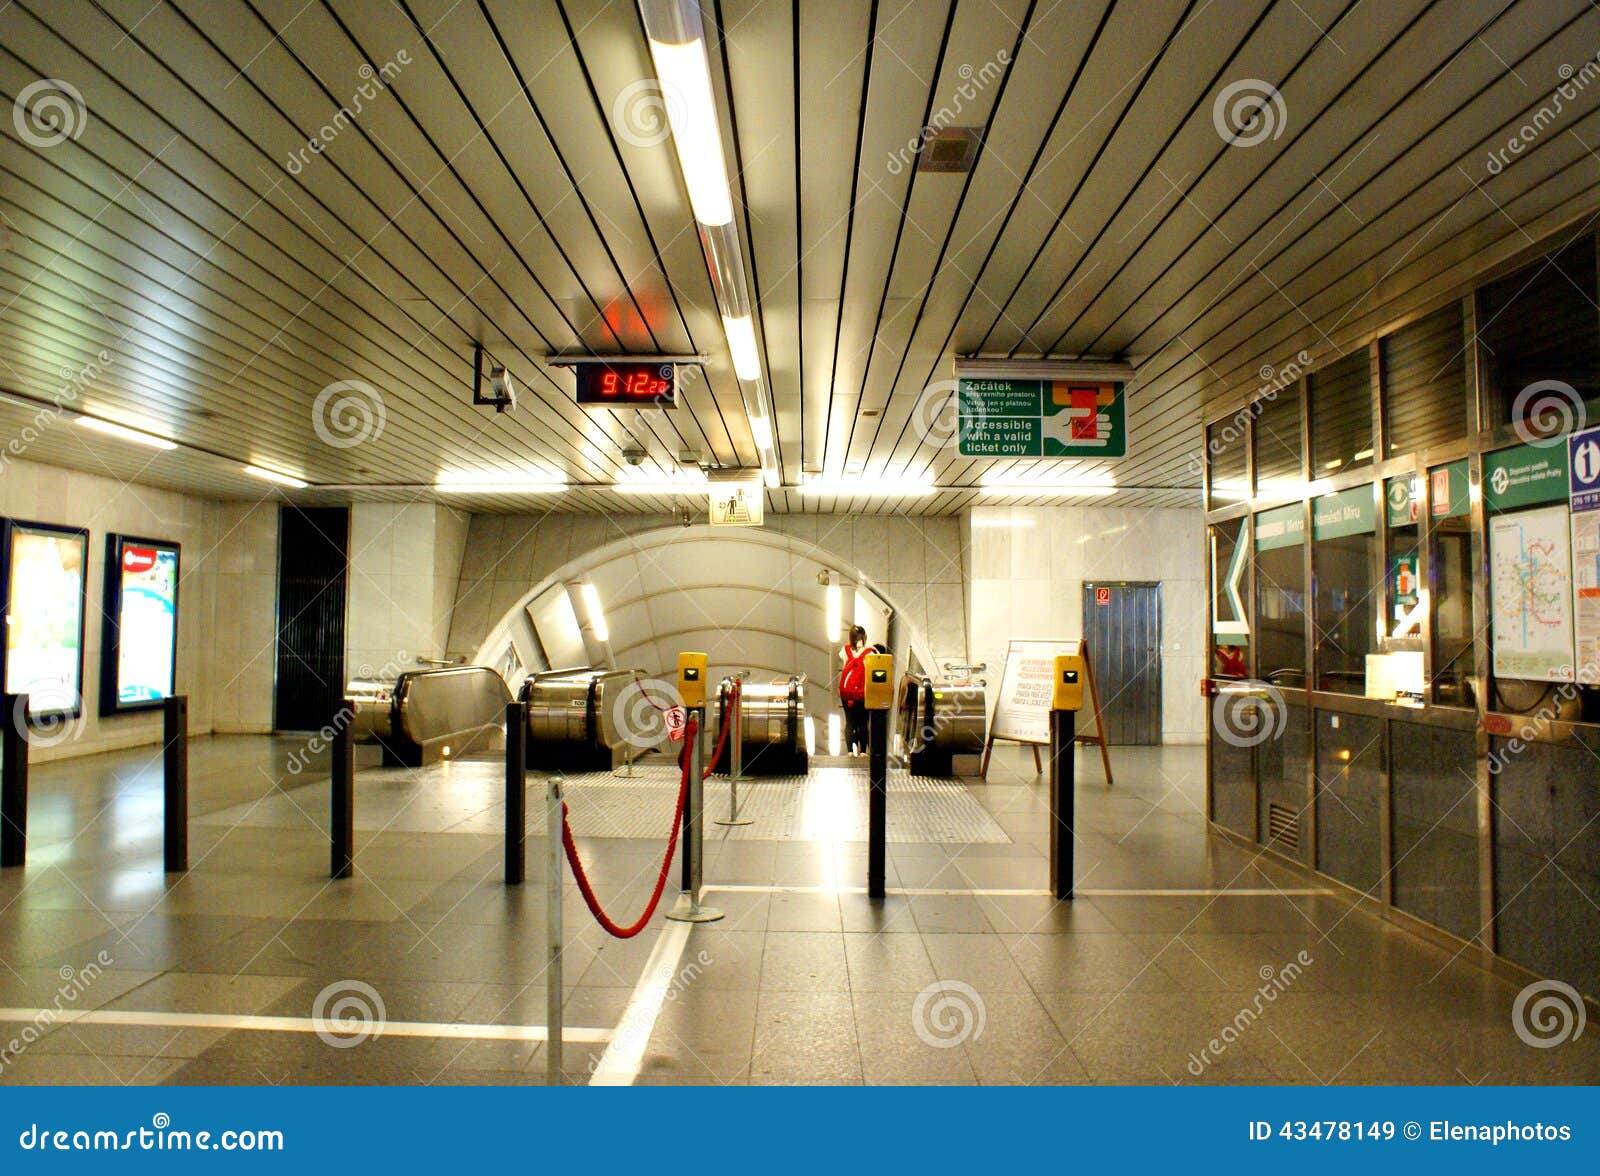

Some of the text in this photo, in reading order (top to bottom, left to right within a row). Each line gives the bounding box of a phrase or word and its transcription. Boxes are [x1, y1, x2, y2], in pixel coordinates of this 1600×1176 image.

[966, 381, 1012, 391] Začátek
[966, 420, 1032, 430] Accessible
[966, 432, 990, 440] with
[1004, 432, 1031, 440] valid
[967, 443, 1027, 454] ticket only
